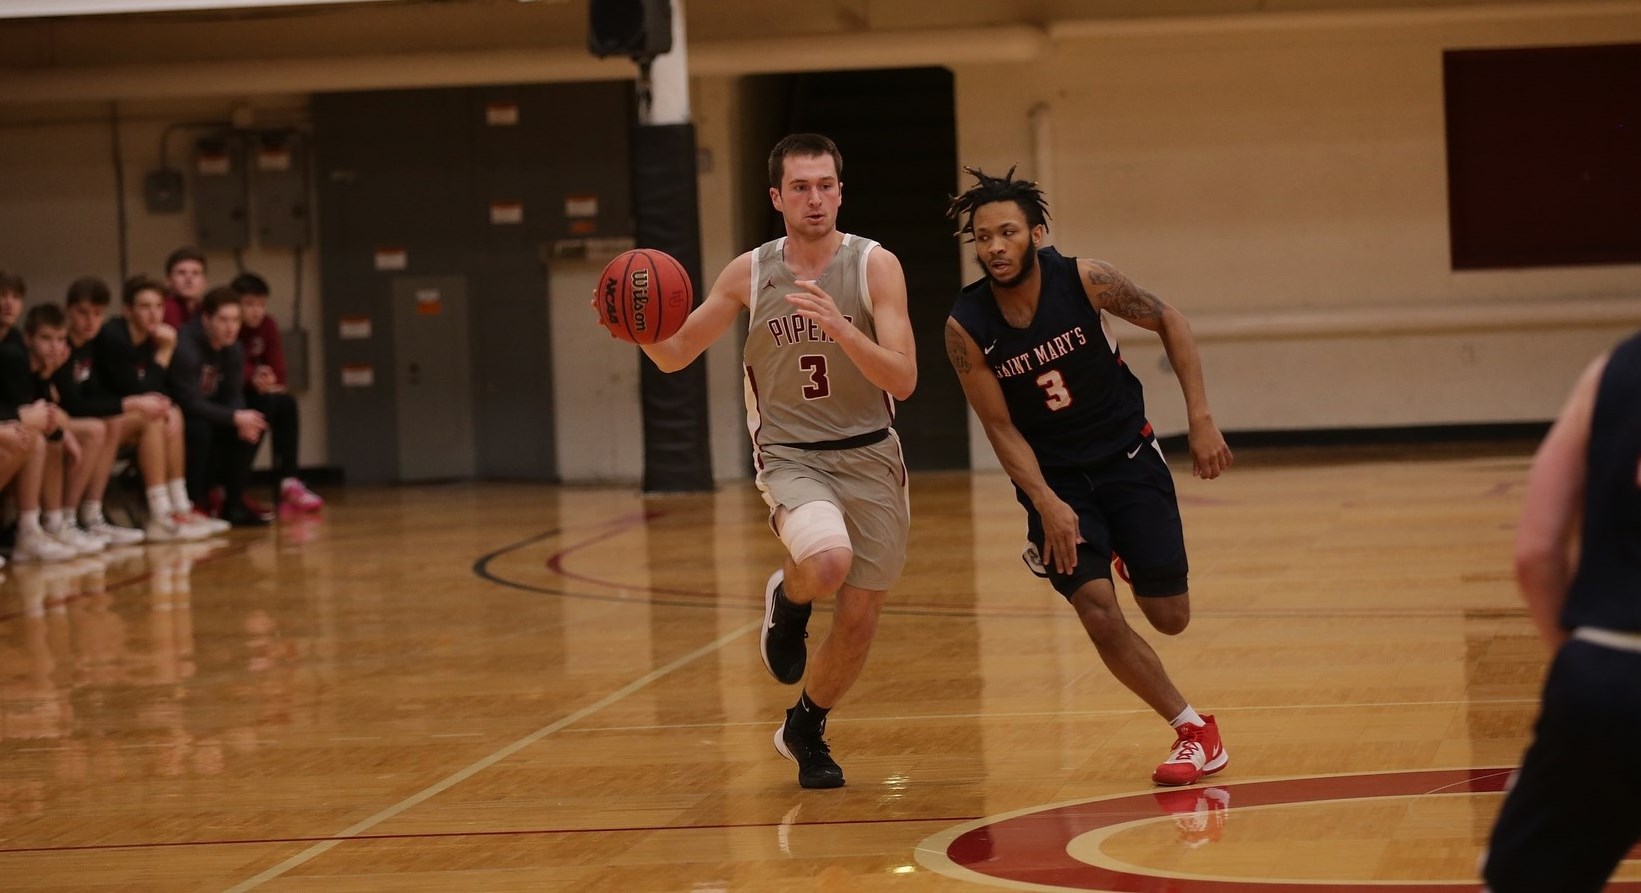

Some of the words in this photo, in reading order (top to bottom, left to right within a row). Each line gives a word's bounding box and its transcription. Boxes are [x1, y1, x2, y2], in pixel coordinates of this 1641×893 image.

[605, 276, 619, 325] NCAA
[630, 268, 649, 332] Wilson
[767, 313, 853, 347] PIPE
[1033, 326, 1087, 366] MARY'S
[799, 354, 831, 401] 3
[1035, 369, 1073, 413] 3
